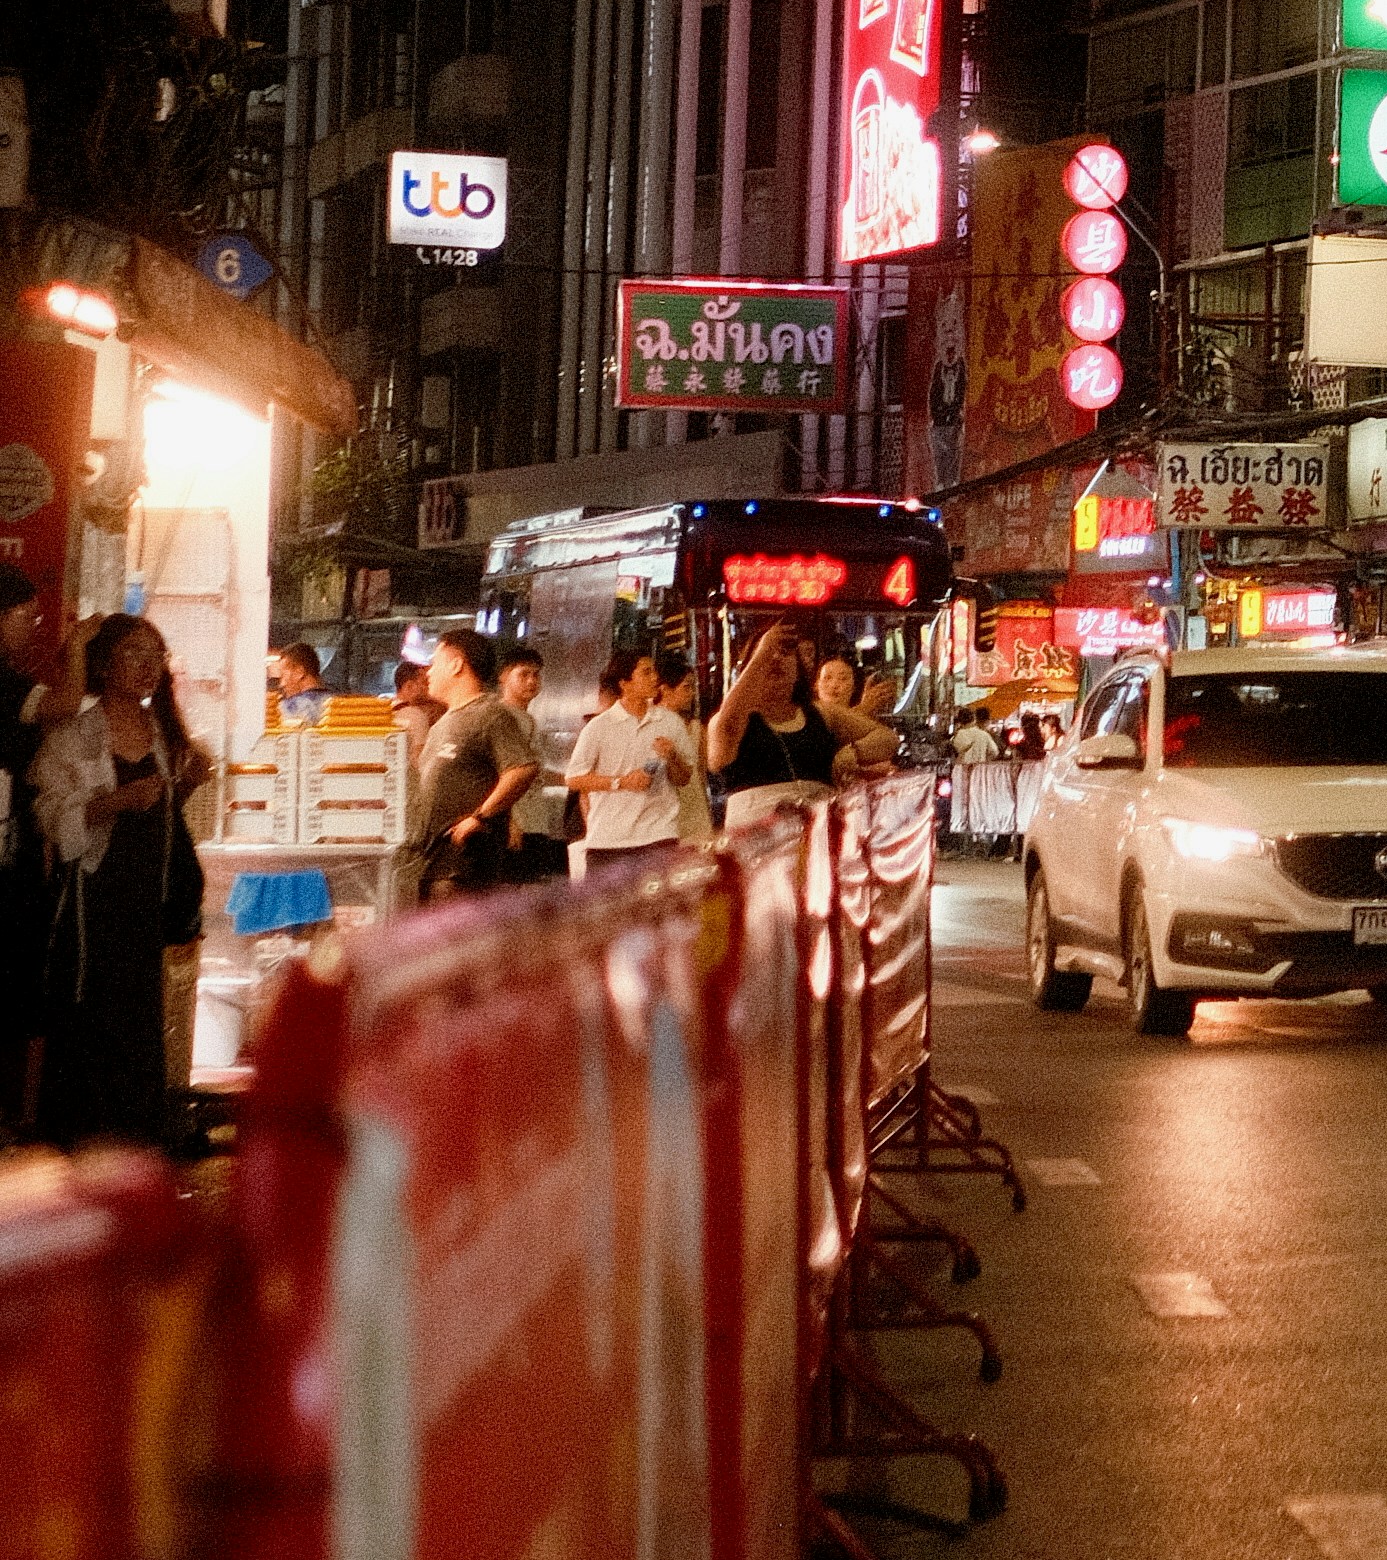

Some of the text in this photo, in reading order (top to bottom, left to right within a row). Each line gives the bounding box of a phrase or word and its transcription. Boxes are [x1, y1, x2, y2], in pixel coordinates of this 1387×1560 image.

[402, 169, 496, 219] ttb
[215, 249, 241, 282] 6
[433, 249, 478, 267] 1428
[1069, 151, 1122, 399] 沙县小吃
[636, 295, 834, 365] ฉ.มั่นคง
[885, 561, 911, 602] 4
